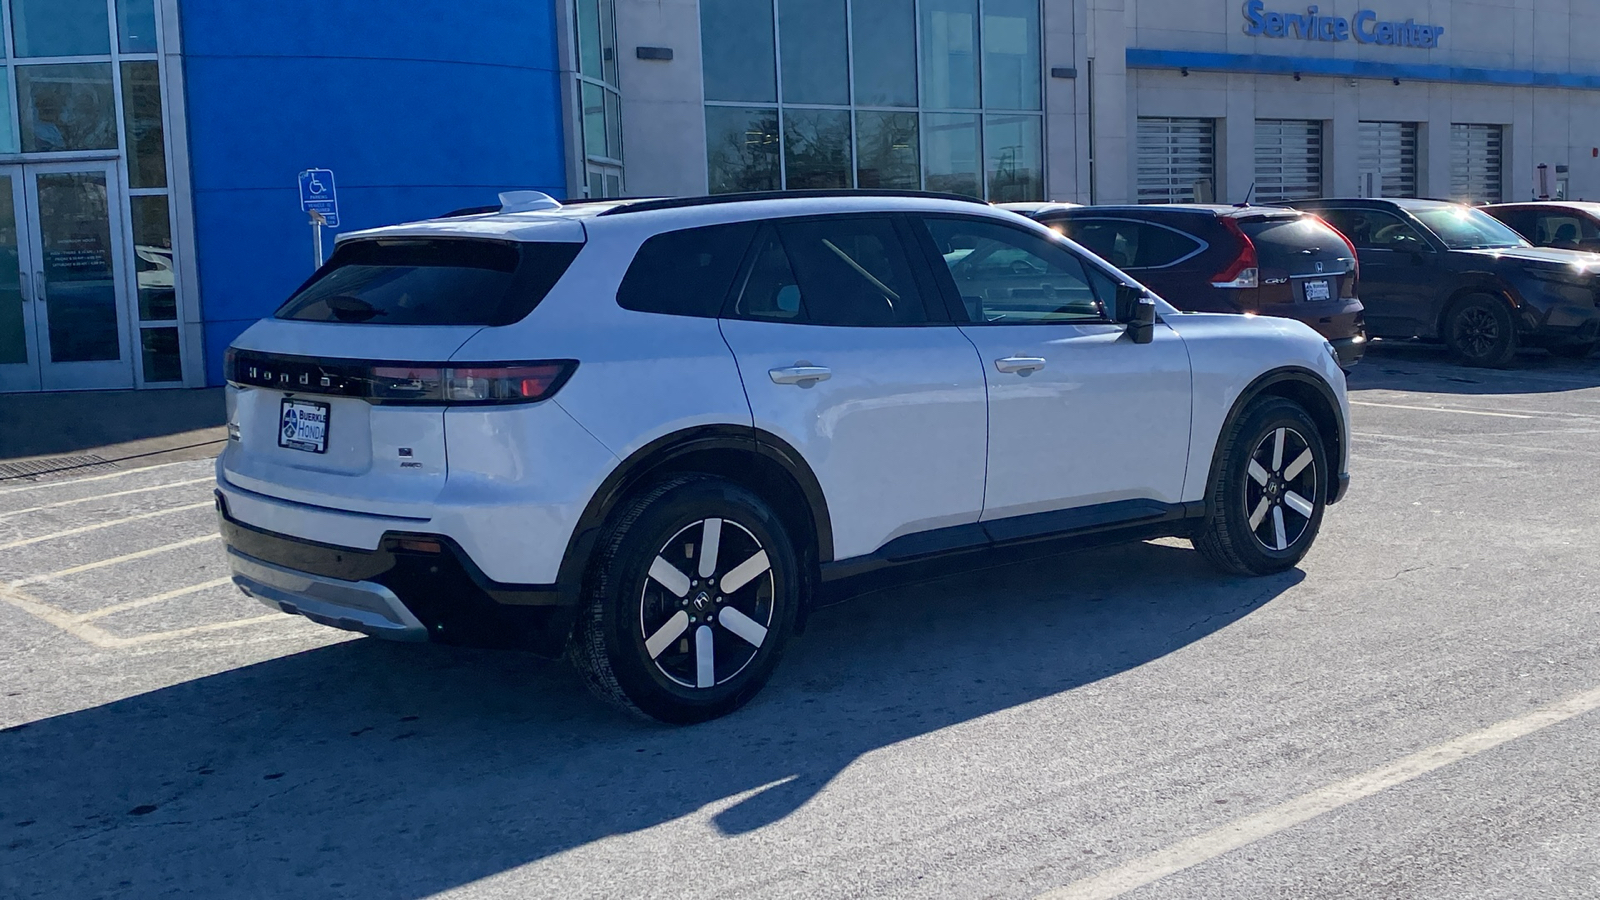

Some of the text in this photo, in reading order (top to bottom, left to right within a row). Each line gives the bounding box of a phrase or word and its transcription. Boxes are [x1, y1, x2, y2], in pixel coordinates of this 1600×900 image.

[1242, 0, 1444, 48] Service Center
[300, 410, 326, 423] BUERKLE
[298, 420, 324, 440] HONDA
